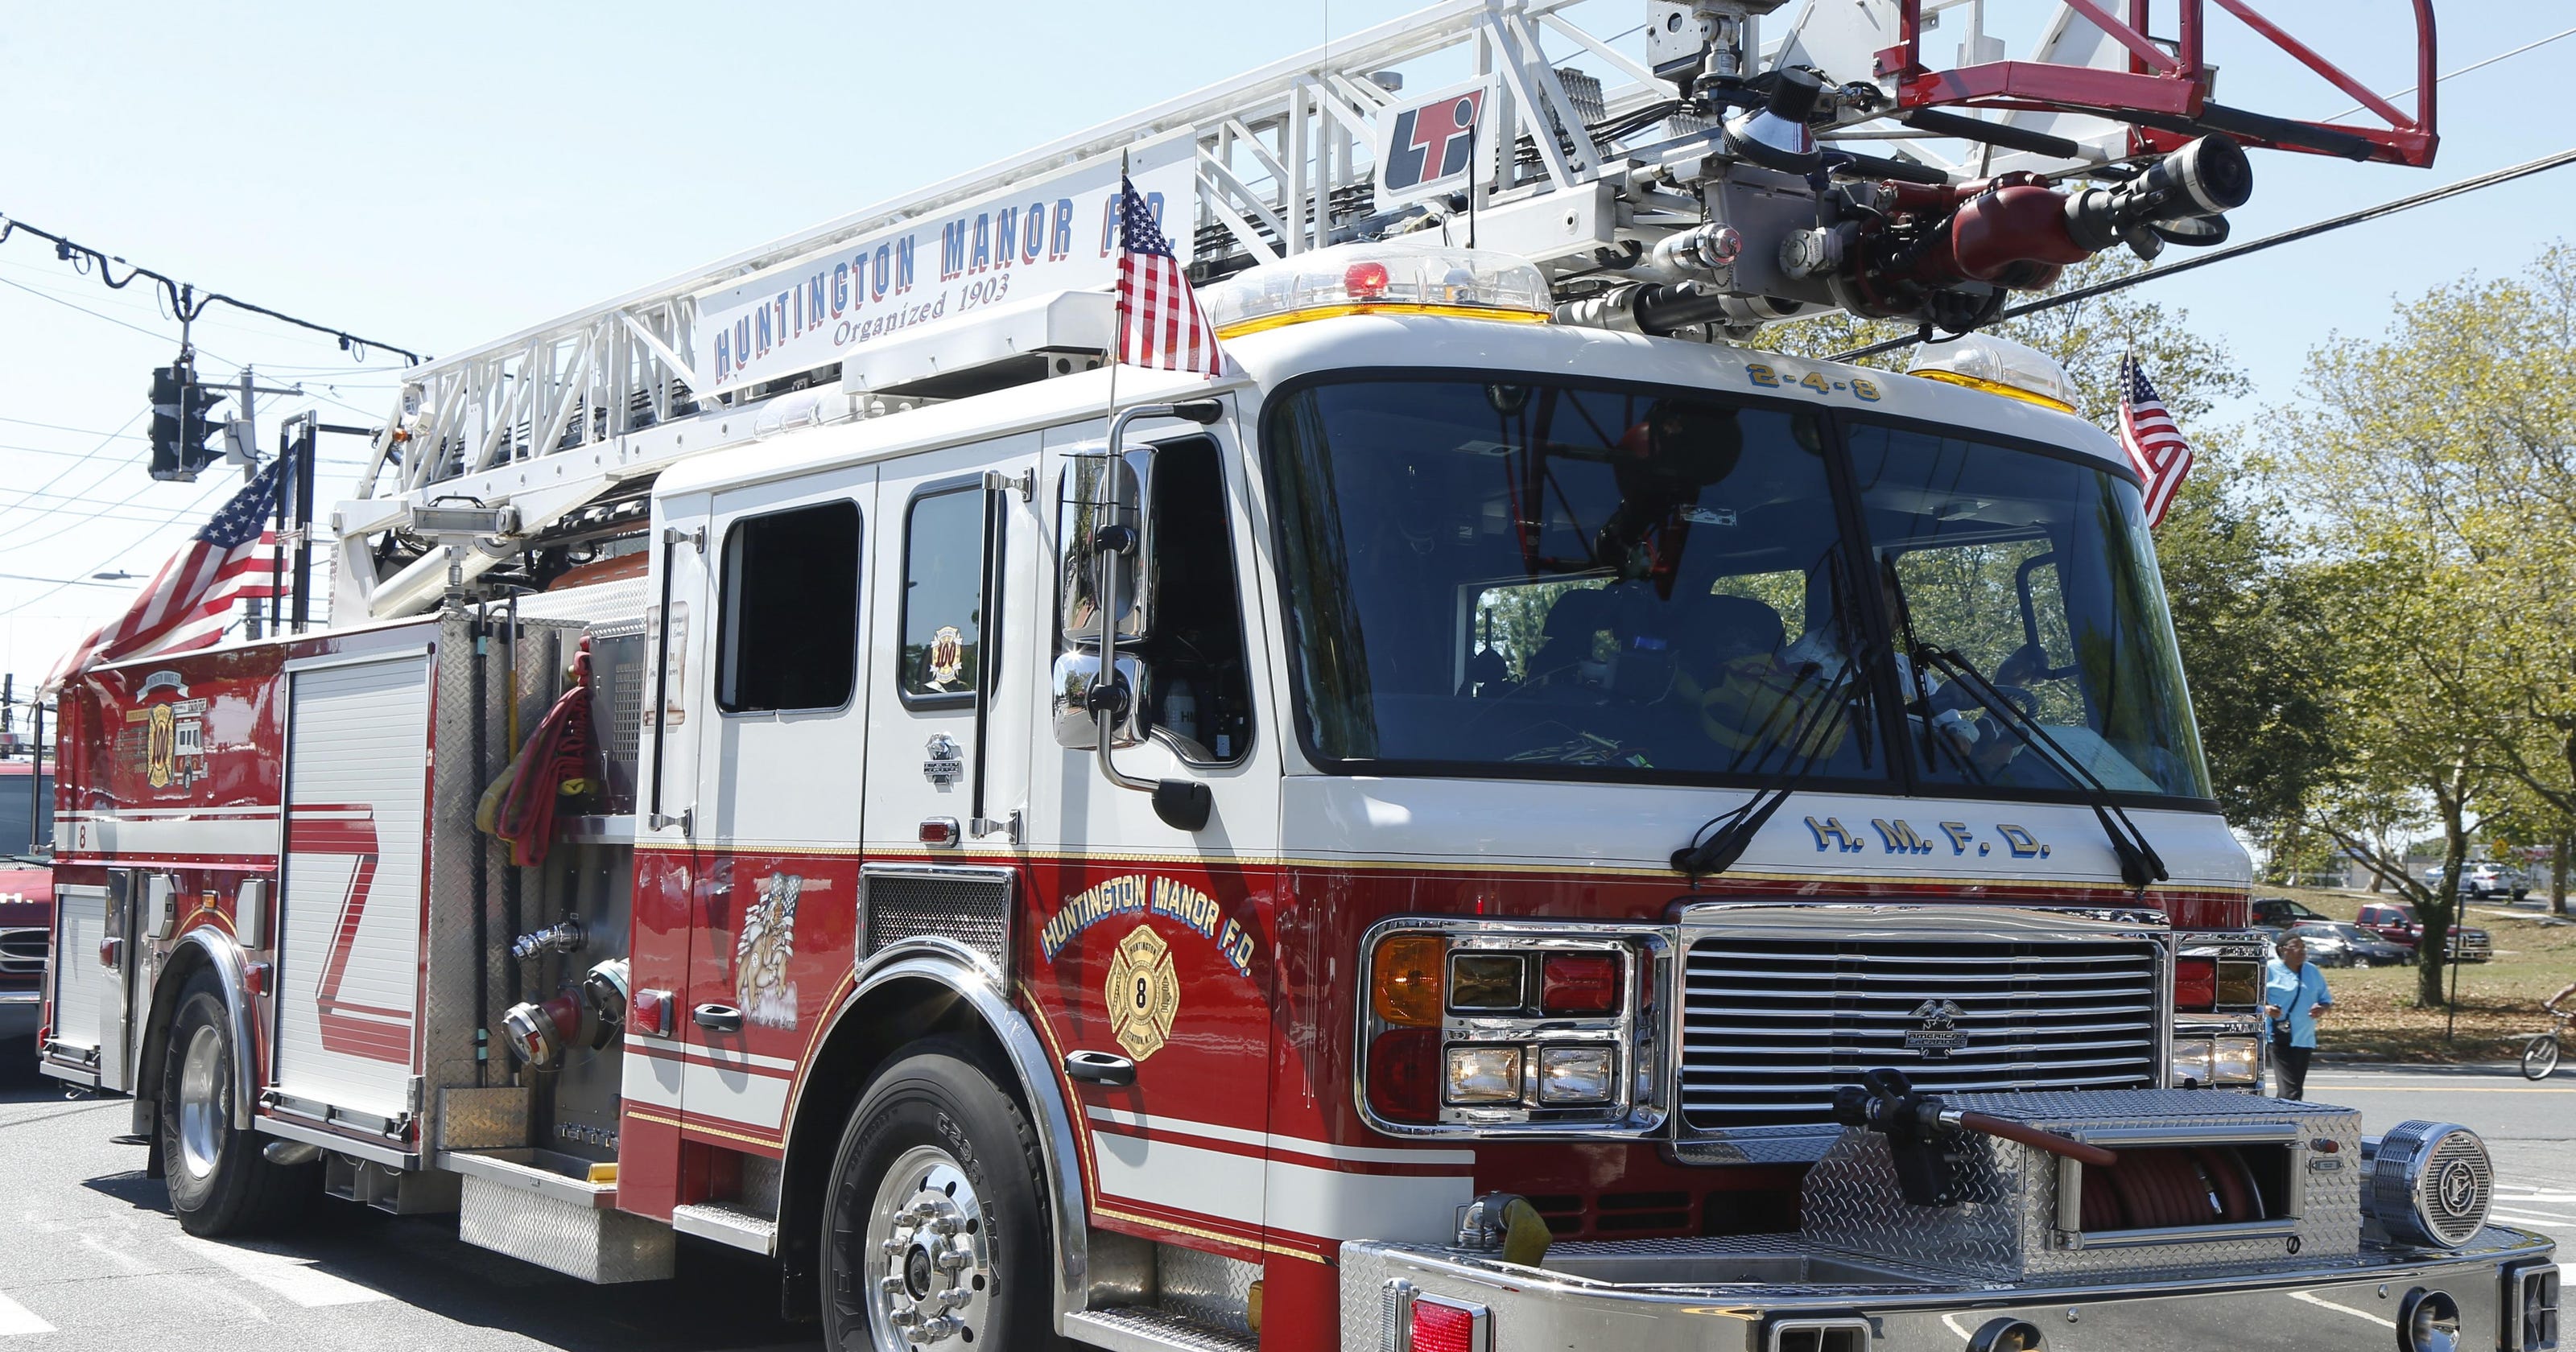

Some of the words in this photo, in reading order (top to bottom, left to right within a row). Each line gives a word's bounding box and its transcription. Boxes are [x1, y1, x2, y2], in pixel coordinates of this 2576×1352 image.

[712, 234, 915, 385] HUNTINGTON
[940, 198, 1074, 282] MANOR
[834, 291, 947, 347] Organized
[958, 274, 1009, 312] 1903
[936, 642, 956, 668] 100
[79, 825, 86, 849] 8
[1040, 874, 1147, 964] HUNTINGTON
[1151, 876, 1220, 940] MANOR
[1218, 917, 1255, 977] F.D.
[1136, 977, 1146, 1008] 8
